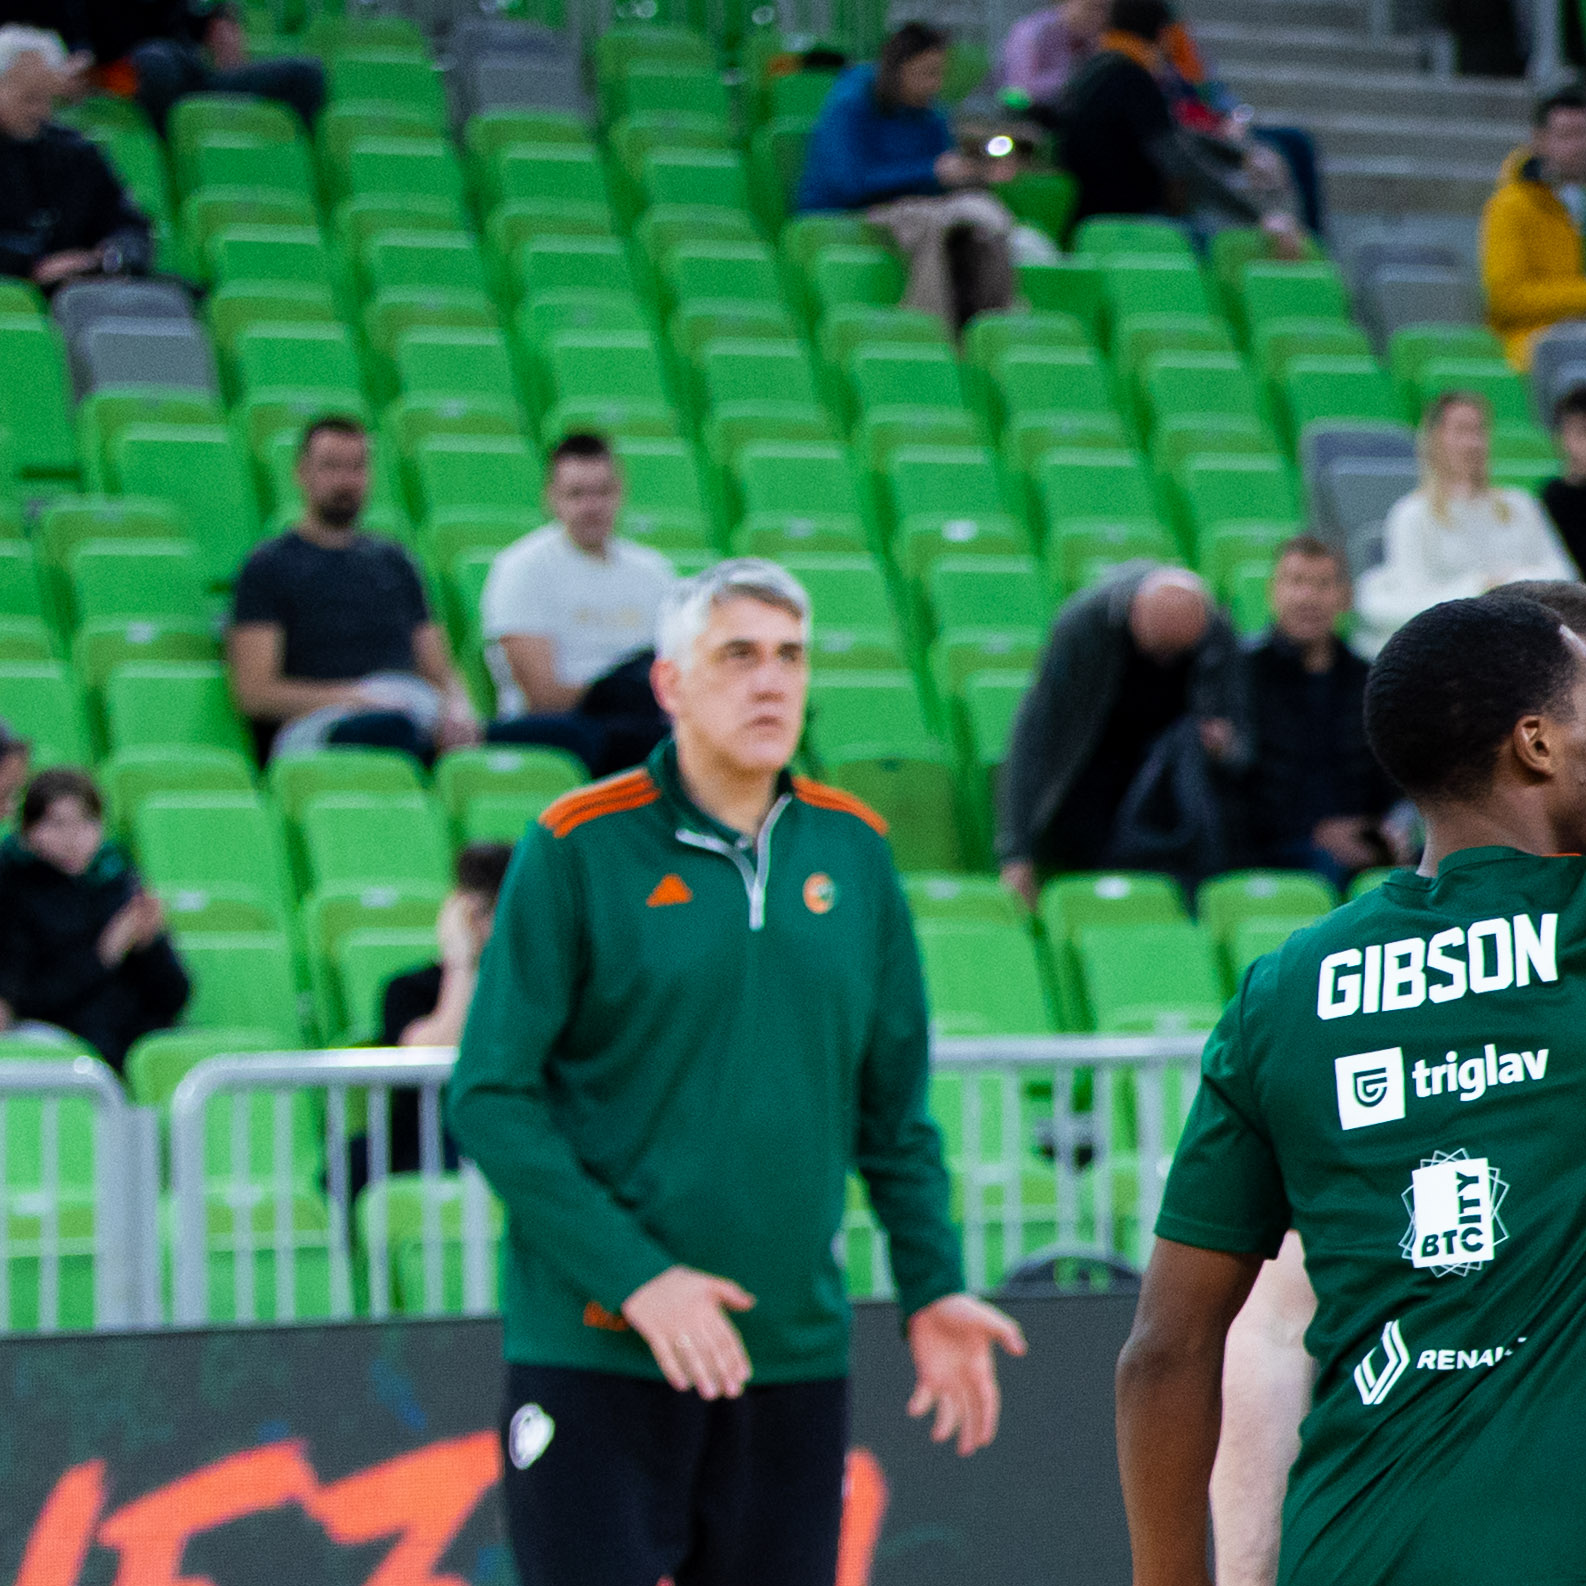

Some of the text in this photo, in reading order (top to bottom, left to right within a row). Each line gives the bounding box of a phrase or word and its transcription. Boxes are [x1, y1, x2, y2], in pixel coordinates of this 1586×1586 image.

[1317, 913, 1558, 1020] GIBSON
[1411, 1043, 1549, 1102] triglav
[1421, 1226, 1484, 1258] BTC
